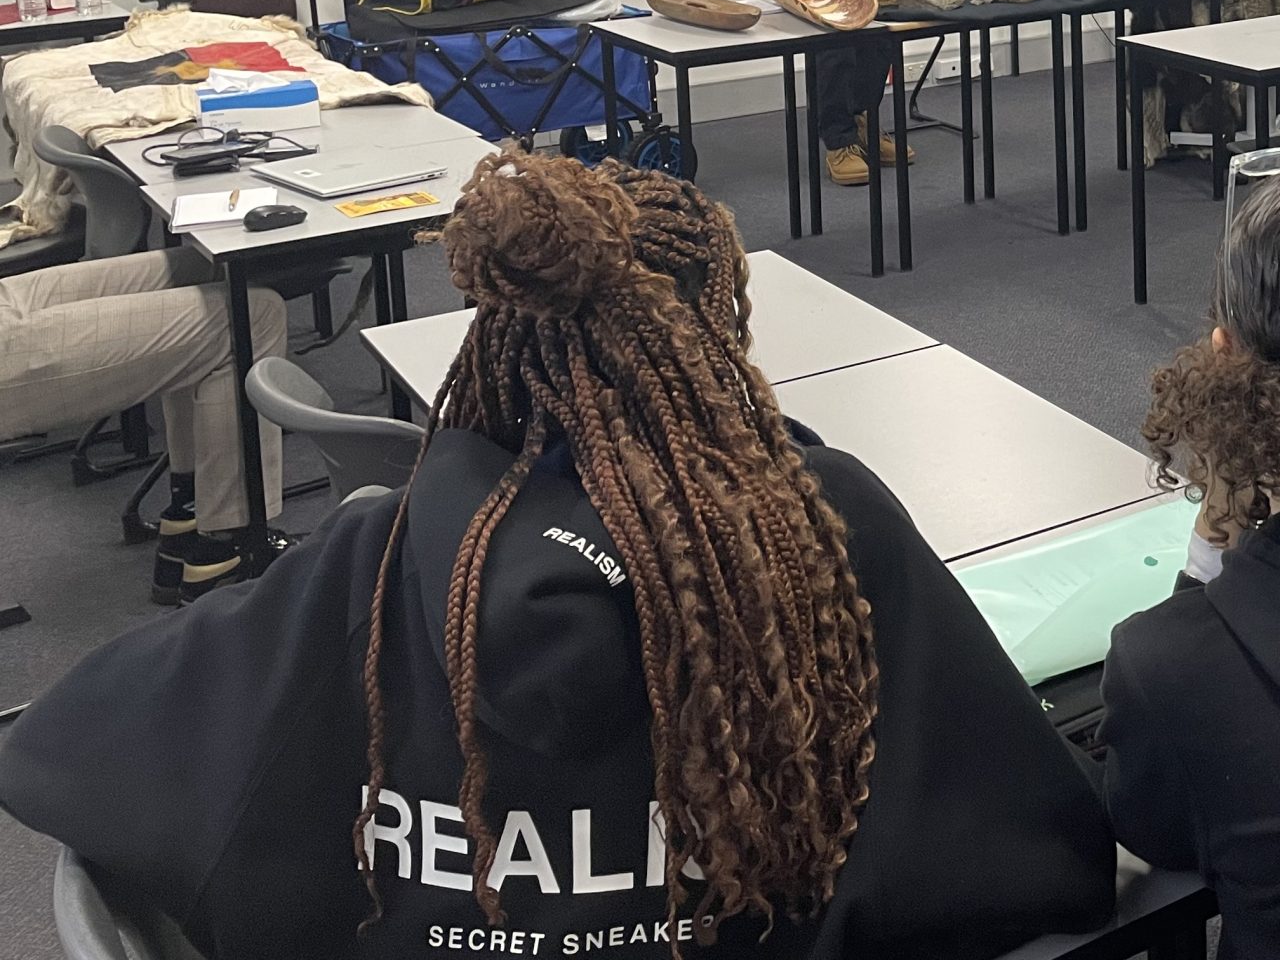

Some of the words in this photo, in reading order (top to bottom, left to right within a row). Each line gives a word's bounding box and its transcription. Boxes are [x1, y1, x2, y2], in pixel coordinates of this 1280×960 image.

[542, 527, 626, 587] REALISM
[357, 784, 706, 895] REALI
[428, 925, 546, 956] SECRET
